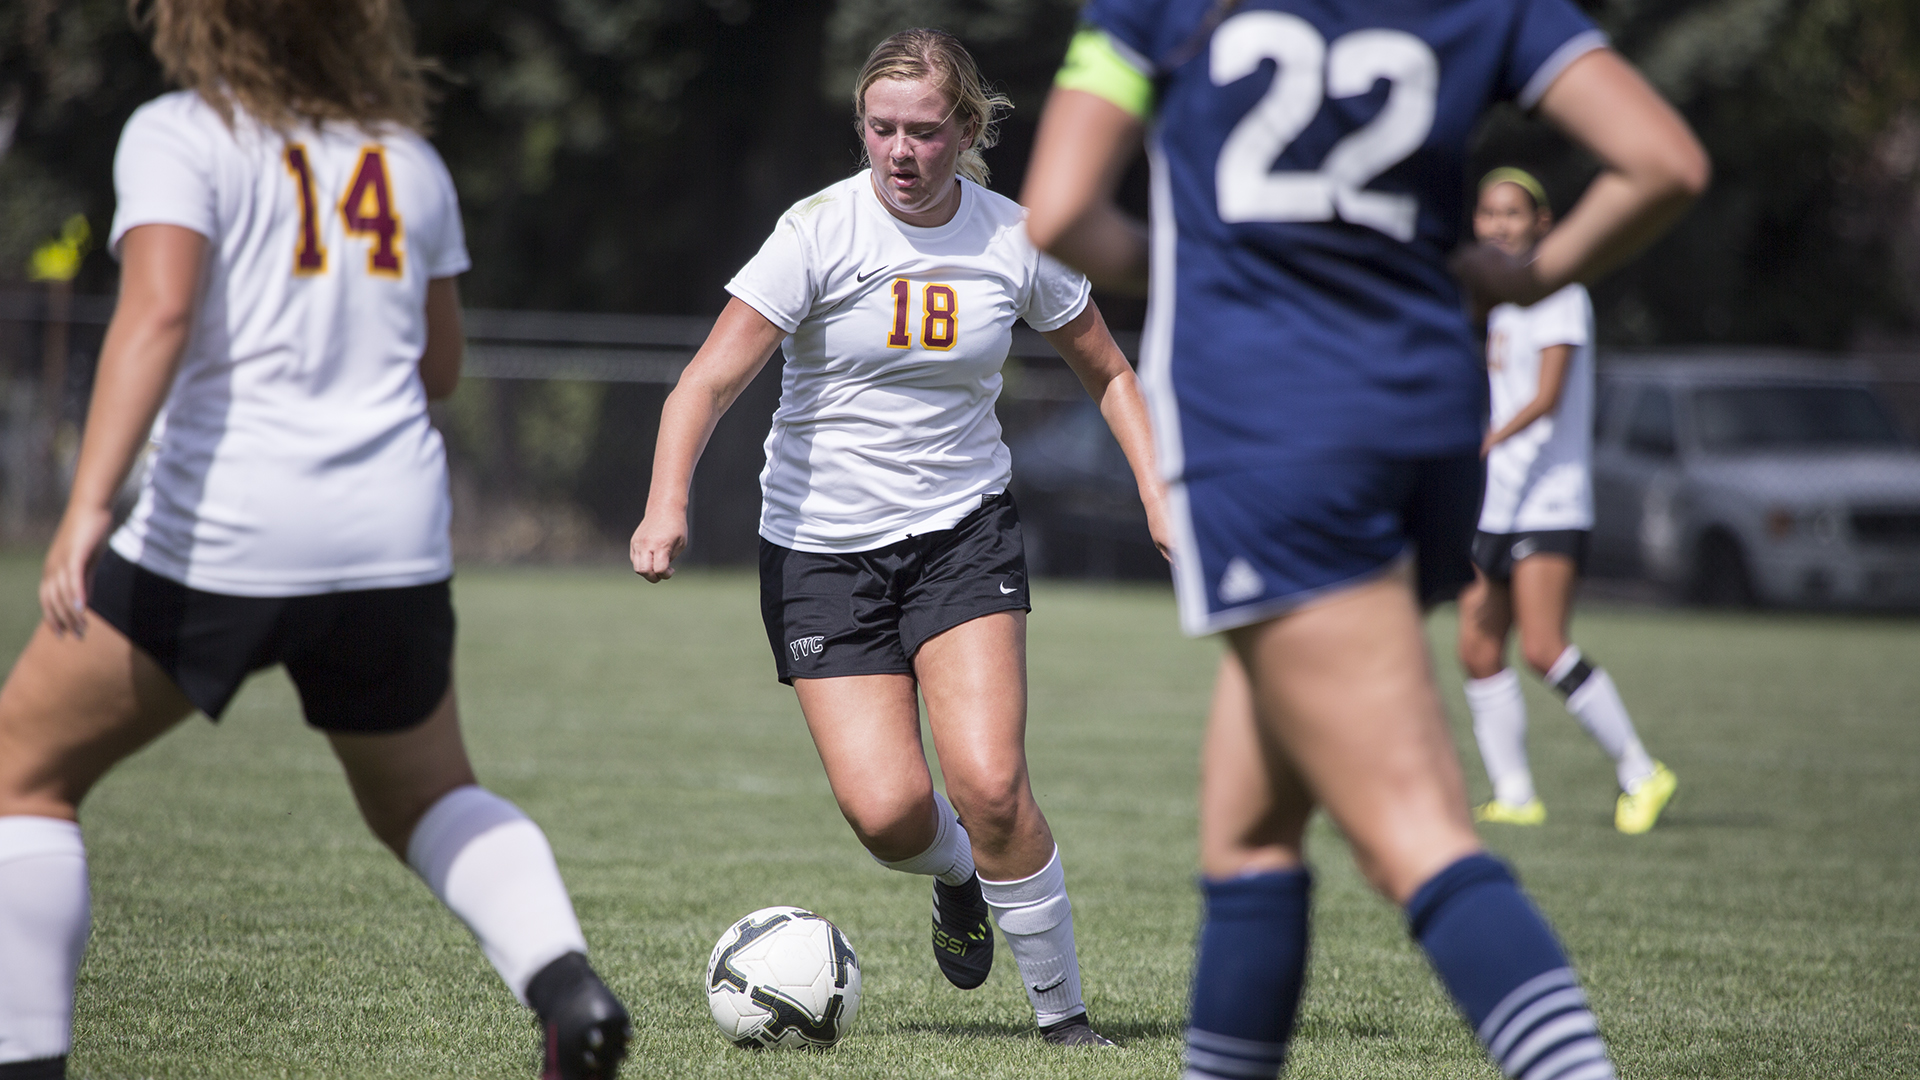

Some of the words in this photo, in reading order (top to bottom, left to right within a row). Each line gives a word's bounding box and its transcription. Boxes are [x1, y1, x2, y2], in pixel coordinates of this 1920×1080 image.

[1209, 9, 1441, 243] 22
[282, 143, 404, 279] 14
[886, 277, 959, 352] 18
[789, 635, 825, 662] YVC
